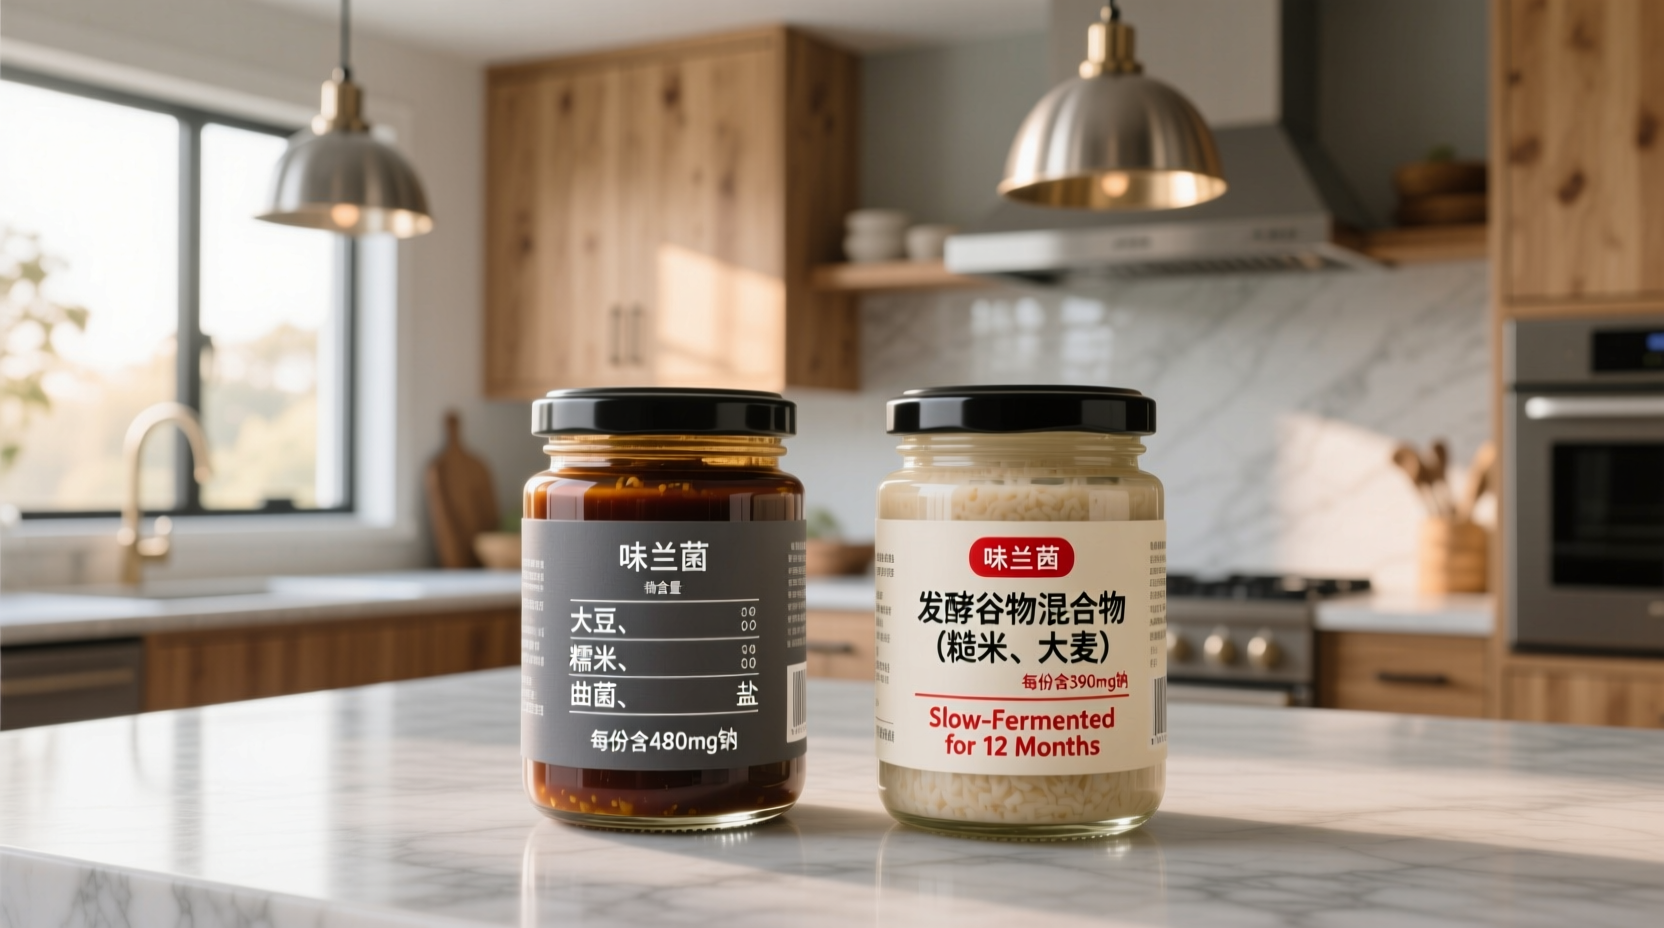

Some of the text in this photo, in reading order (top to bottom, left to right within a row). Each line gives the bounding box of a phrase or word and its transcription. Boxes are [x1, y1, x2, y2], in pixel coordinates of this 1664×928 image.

[619, 541, 709, 572] 味兰菌
[570, 605, 626, 634] 大豆、
[917, 590, 1126, 626] 发酵谷物混合物
[569, 644, 627, 672] 糯米、
[570, 680, 759, 708] 曲菌、 盐
[929, 706, 1116, 731] Slow-Fermented
[945, 733, 1101, 757] for 12 Months
